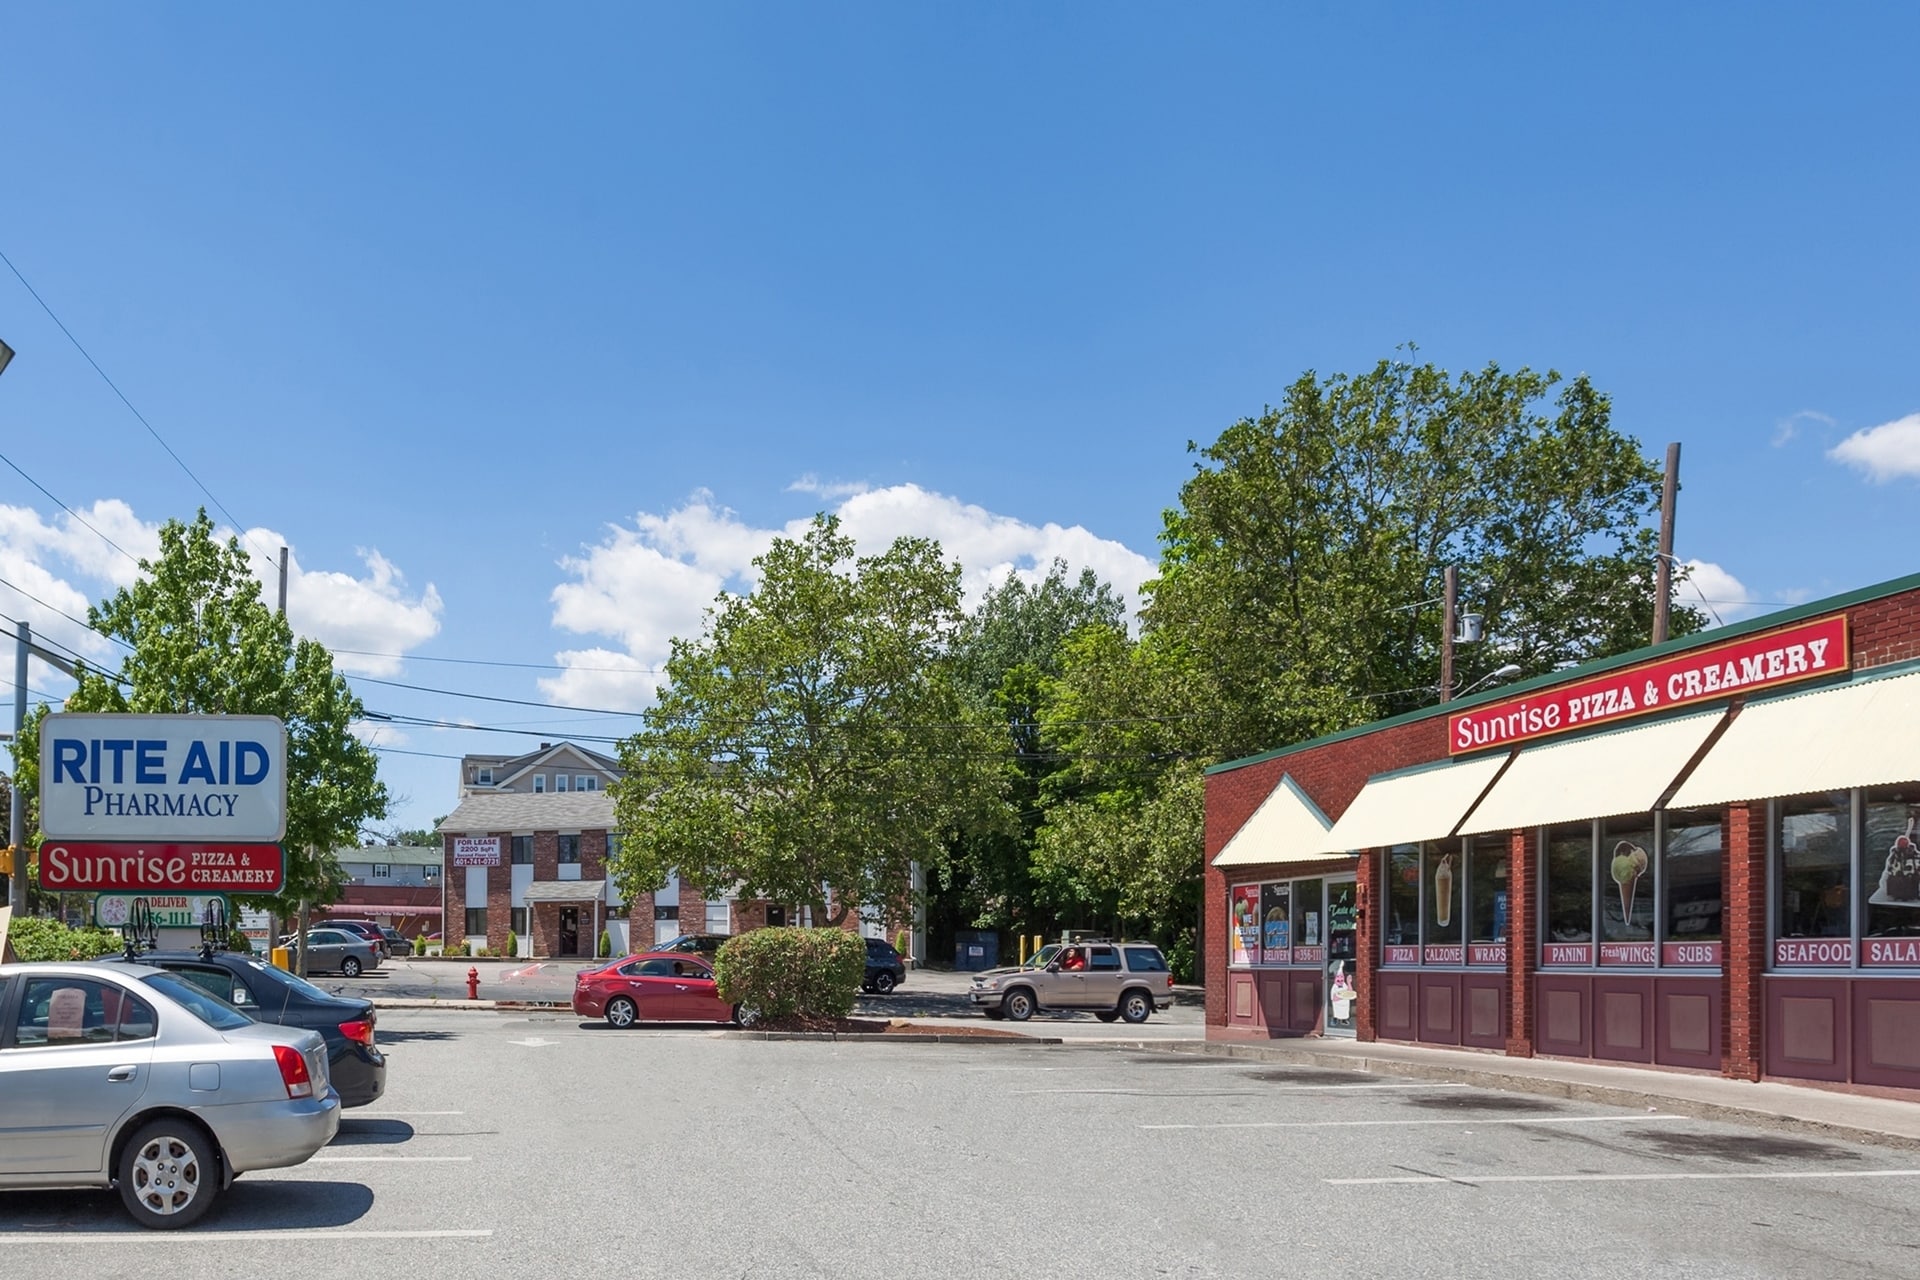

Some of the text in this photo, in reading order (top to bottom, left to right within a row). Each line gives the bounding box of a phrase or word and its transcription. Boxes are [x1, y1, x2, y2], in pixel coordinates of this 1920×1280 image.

[1457, 638, 1829, 748] Sunrise PIZZA & CREAMERY
[53, 738, 271, 786] RITE AID
[48, 846, 187, 884] Sunrise
[191, 851, 251, 867] PIZZA &
[191, 868, 275, 884] CREAMERY
[151, 896, 188, 908] DELIVER
[1392, 948, 1414, 962] PIZZA
[1474, 948, 1507, 962] WRAPS
[1552, 947, 1587, 962] PANINI
[1601, 946, 1656, 962] Fresh WINGS
[1677, 946, 1713, 963] SUBS
[1777, 943, 1852, 962] SEAFOOD
[1870, 942, 1920, 962] SALA
